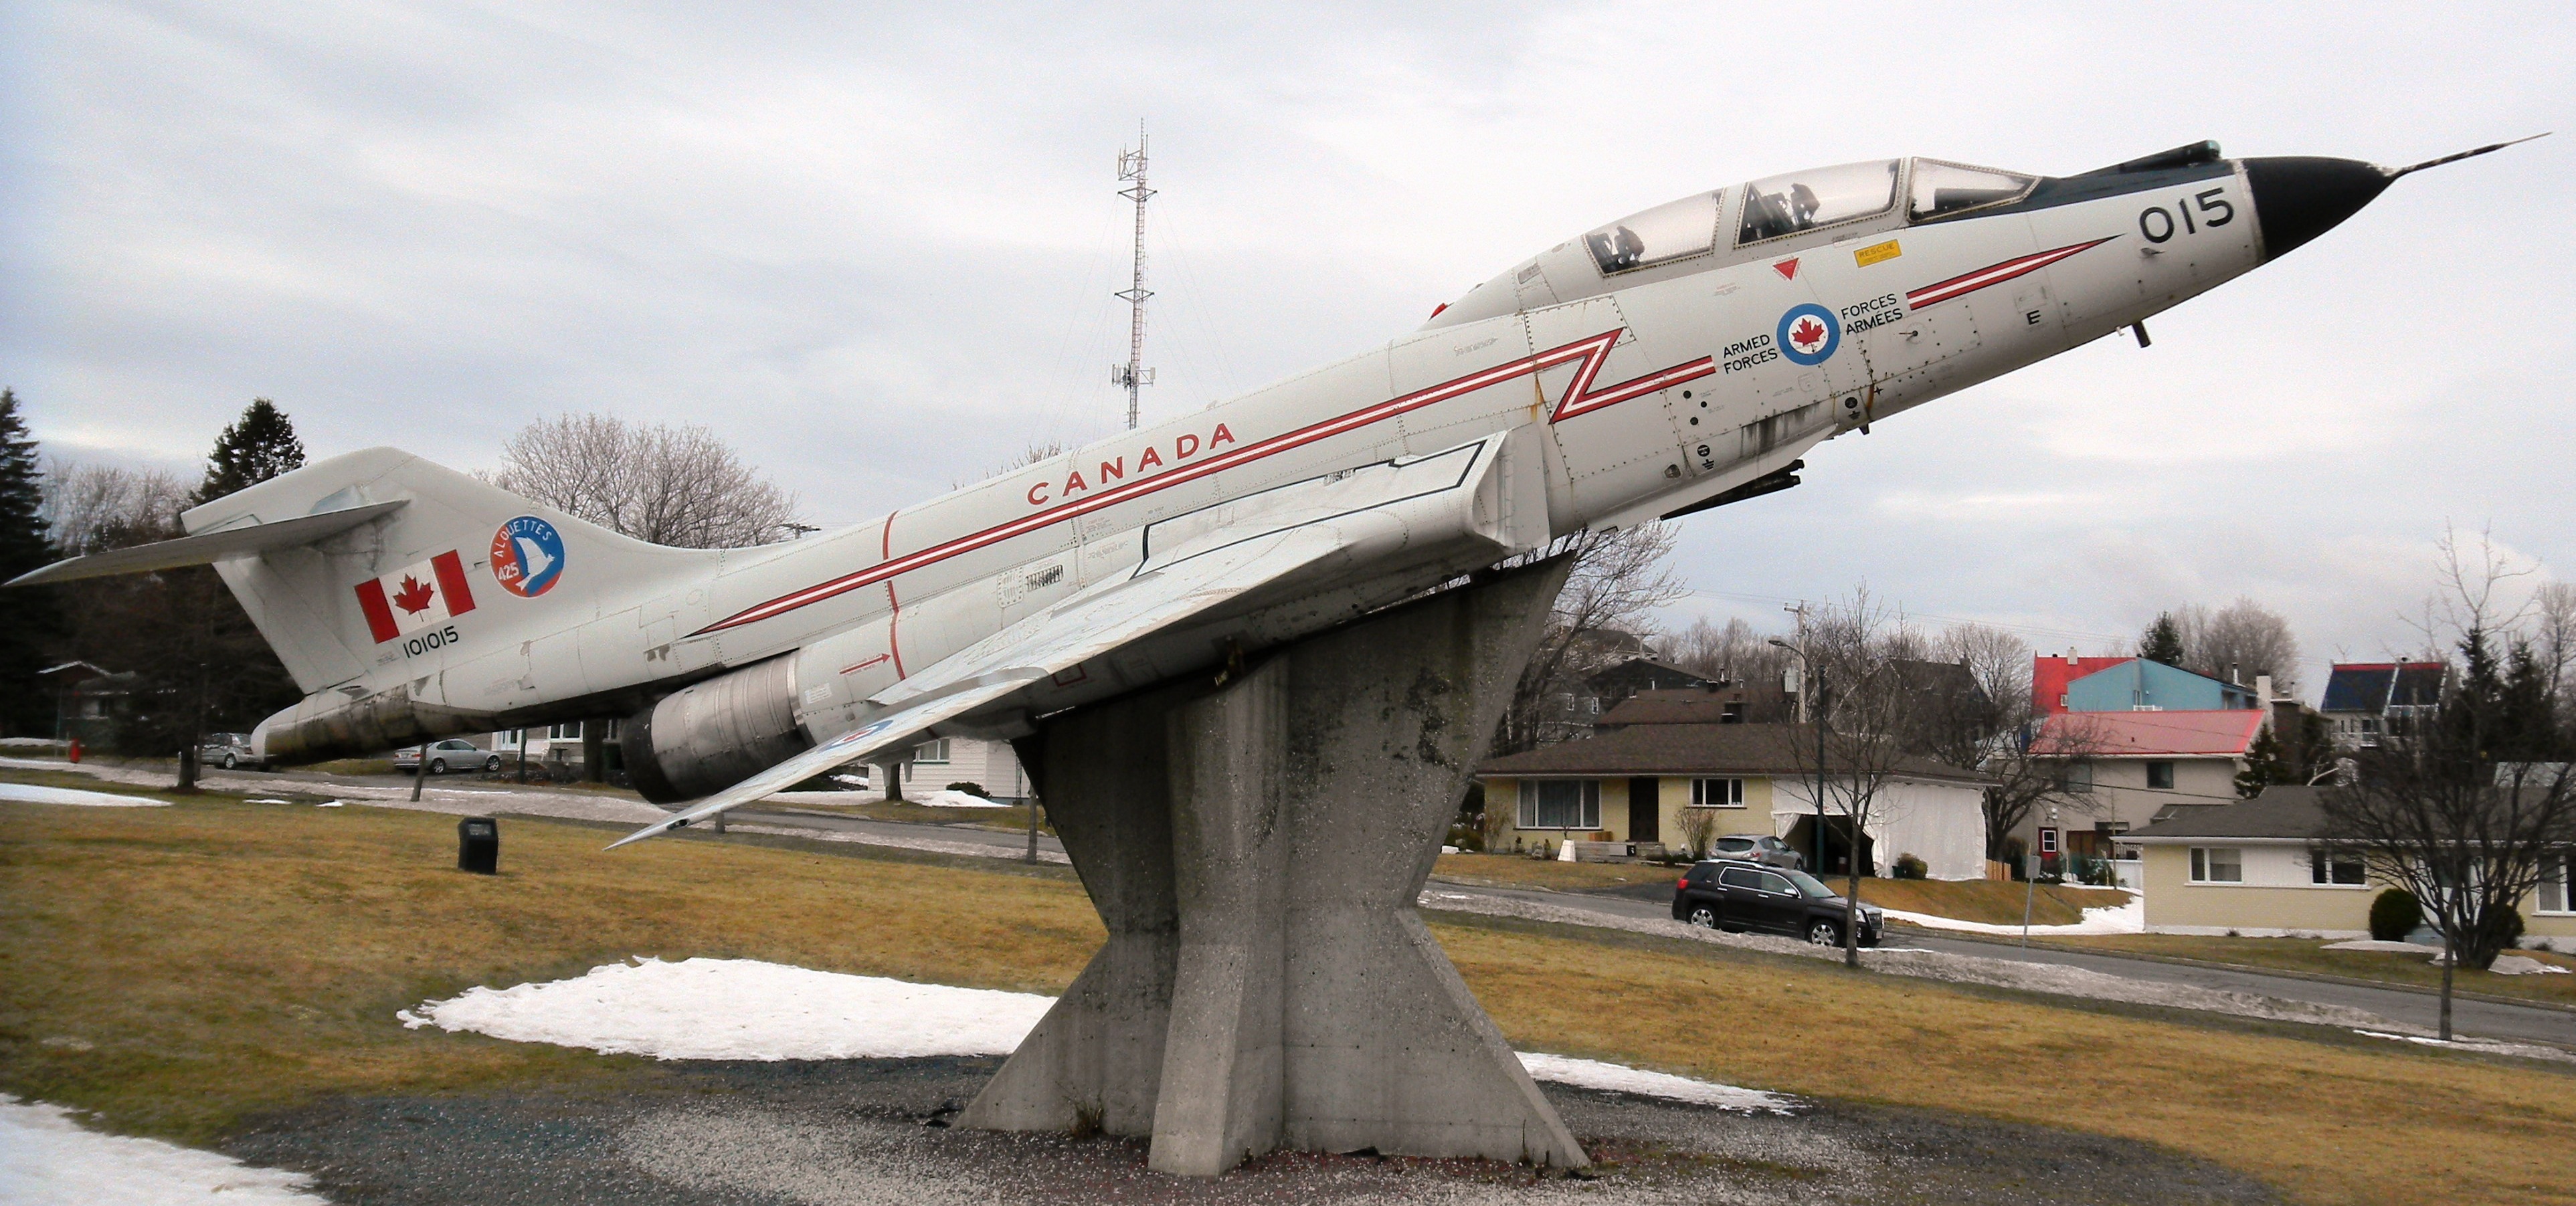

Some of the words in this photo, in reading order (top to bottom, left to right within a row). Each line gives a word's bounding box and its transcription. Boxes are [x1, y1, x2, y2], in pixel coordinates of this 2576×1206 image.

[2139, 187, 2234, 243] 015
[1858, 242, 1895, 258] RESCUE
[1841, 294, 1897, 320] FORCES
[2026, 309, 2041, 325] E
[1846, 308, 1903, 335] ARMÉES
[1723, 334, 1770, 359] ARMED
[1724, 348, 1778, 375] FORCES
[1027, 423, 1236, 505] CANADA
[493, 520, 553, 558] ALOUETTES
[498, 561, 520, 581] 425
[403, 625, 459, 659] 101015
